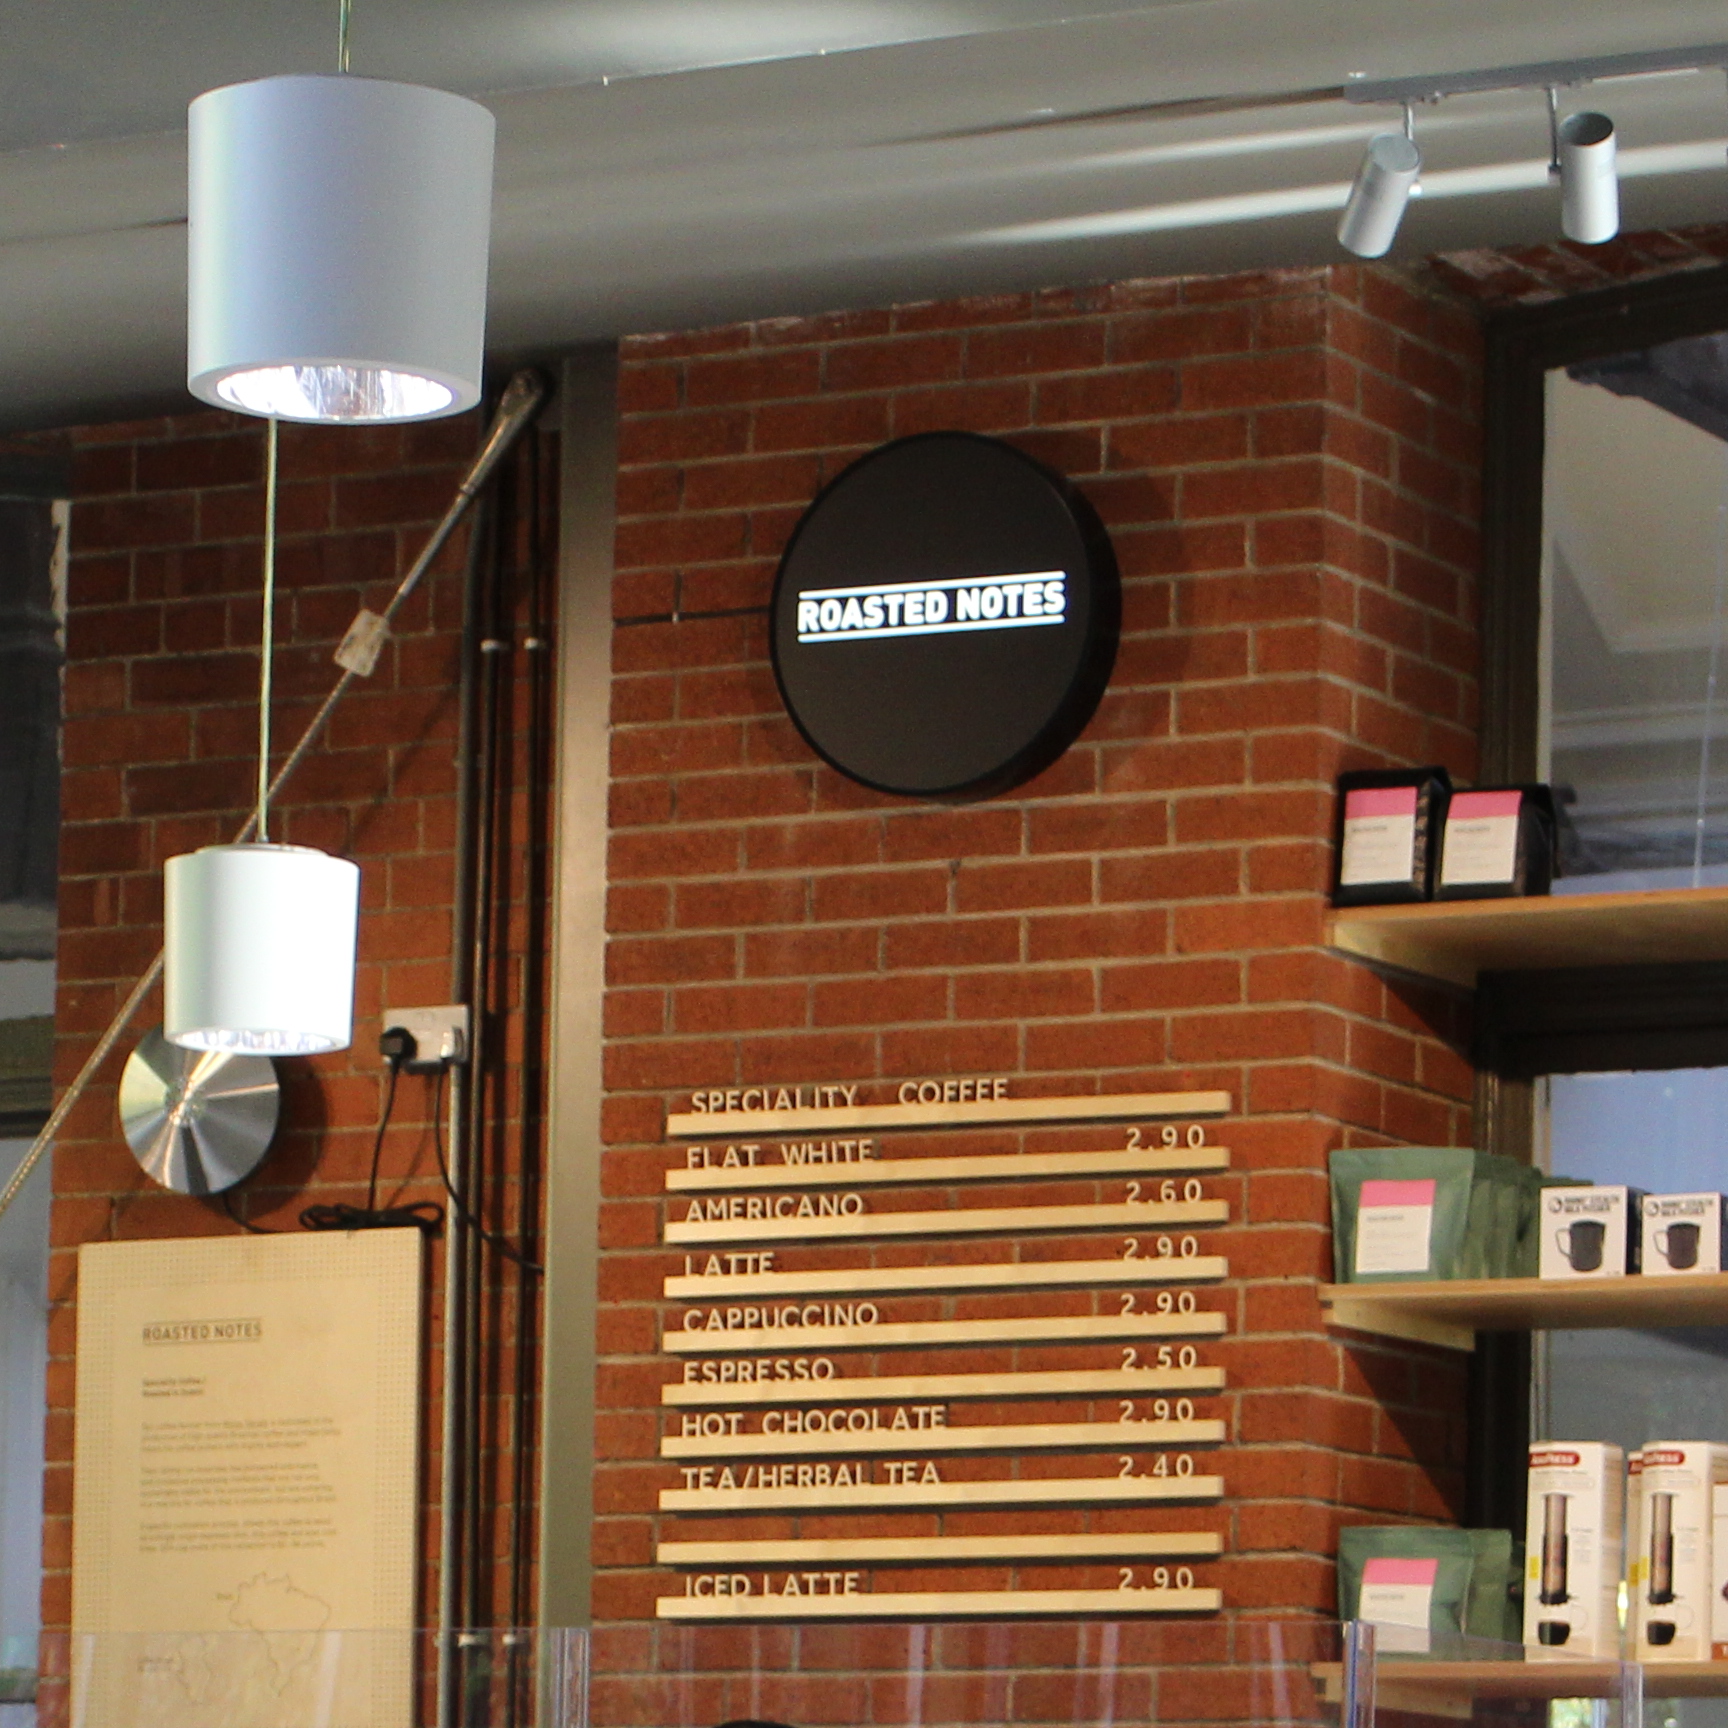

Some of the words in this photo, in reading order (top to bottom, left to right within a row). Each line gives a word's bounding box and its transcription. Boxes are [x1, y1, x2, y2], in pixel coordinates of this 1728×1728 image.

[798, 591, 948, 633] ROASTED
[956, 581, 1066, 622] NOTES
[691, 1086, 857, 1114] SPECIALITY
[899, 1080, 1008, 1105] COFFEE
[686, 1144, 760, 1169] FLAT
[781, 1139, 873, 1165] WHITE
[1126, 1125, 1205, 1152] 2.90
[685, 1194, 863, 1222] AMERICANO
[1125, 1180, 1202, 1205] 2.60
[684, 1252, 774, 1277] LATTE
[1123, 1236, 1199, 1260] 2.90
[142, 1325, 209, 1341] ROASTED
[213, 1322, 262, 1337] NOTES
[683, 1303, 878, 1332] CAPPUCCINO
[1120, 1292, 1196, 1316] 2.90
[683, 1358, 834, 1386] ESPRESSO
[1121, 1346, 1197, 1370] 2.50
[681, 1412, 742, 1438] HOT
[762, 1405, 947, 1434] CHOCOLATE
[1119, 1400, 1194, 1424] 2.90
[680, 1463, 869, 1491] TEA/HERBAL
[884, 1461, 941, 1486] TEA
[1118, 1455, 1194, 1479] 2.40
[685, 1573, 751, 1598] ICED
[763, 1572, 859, 1597] LATTE
[1118, 1567, 1193, 1590] 2.90
